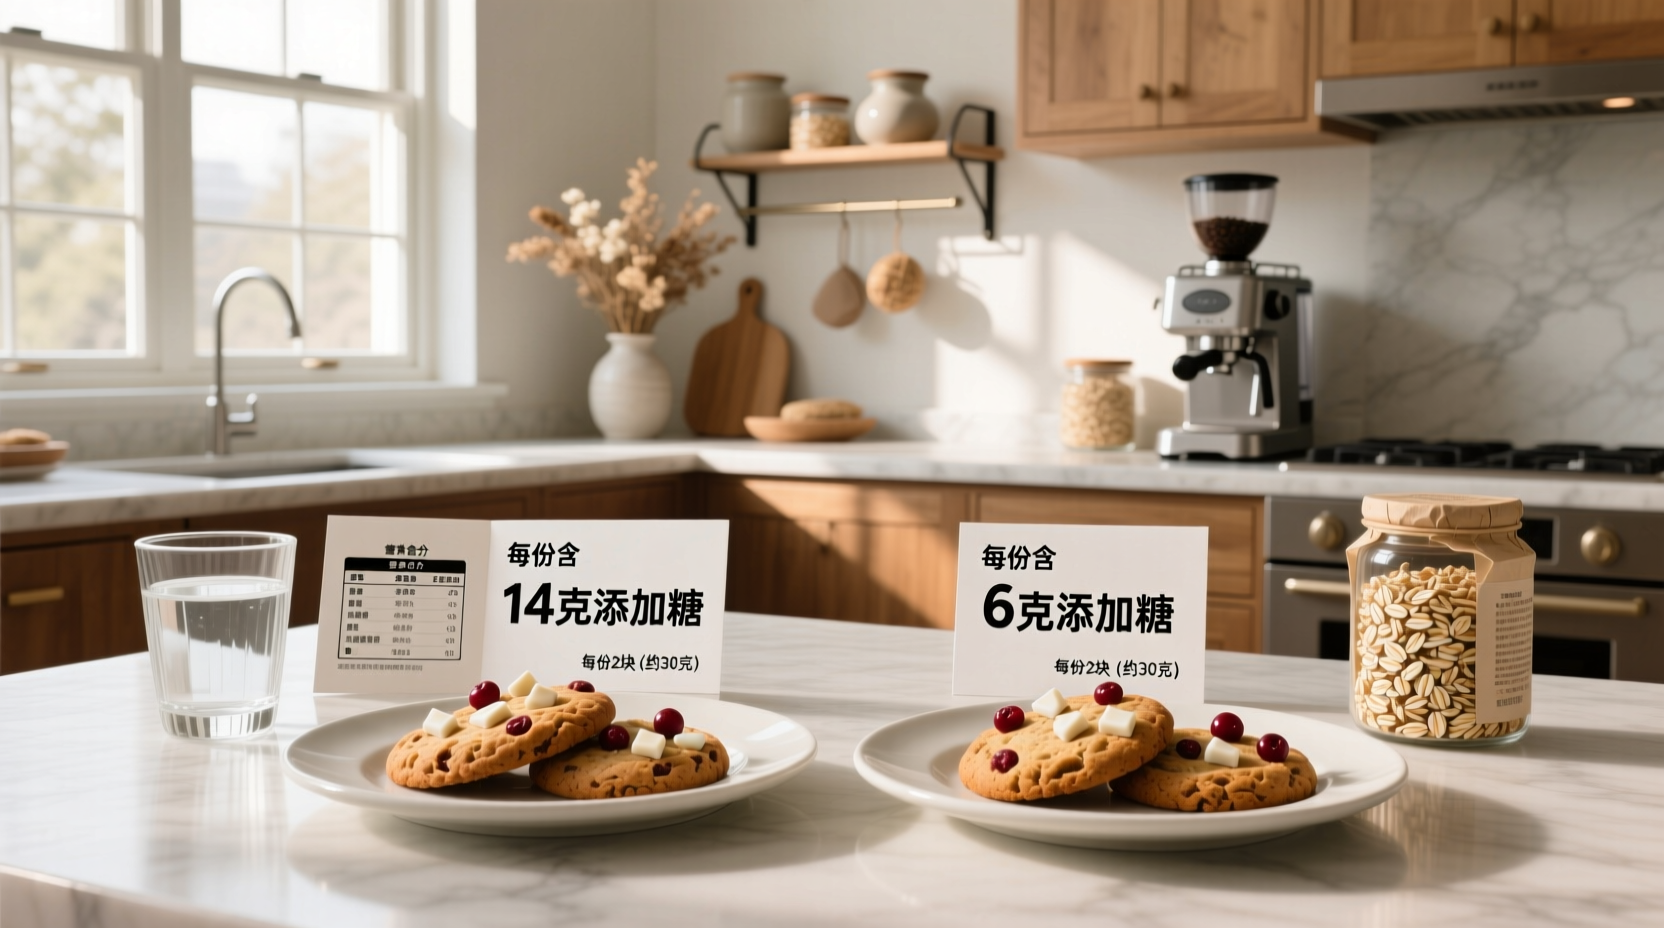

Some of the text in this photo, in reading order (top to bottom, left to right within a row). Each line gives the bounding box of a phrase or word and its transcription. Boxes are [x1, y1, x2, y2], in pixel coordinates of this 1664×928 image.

[507, 541, 580, 568] 每份含
[981, 544, 1057, 571] 每份含
[503, 582, 704, 627] 14克添加糖
[983, 583, 1175, 634] 6克添加糖
[581, 653, 636, 672] 每份2块
[1053, 658, 1111, 677] 每份2块
